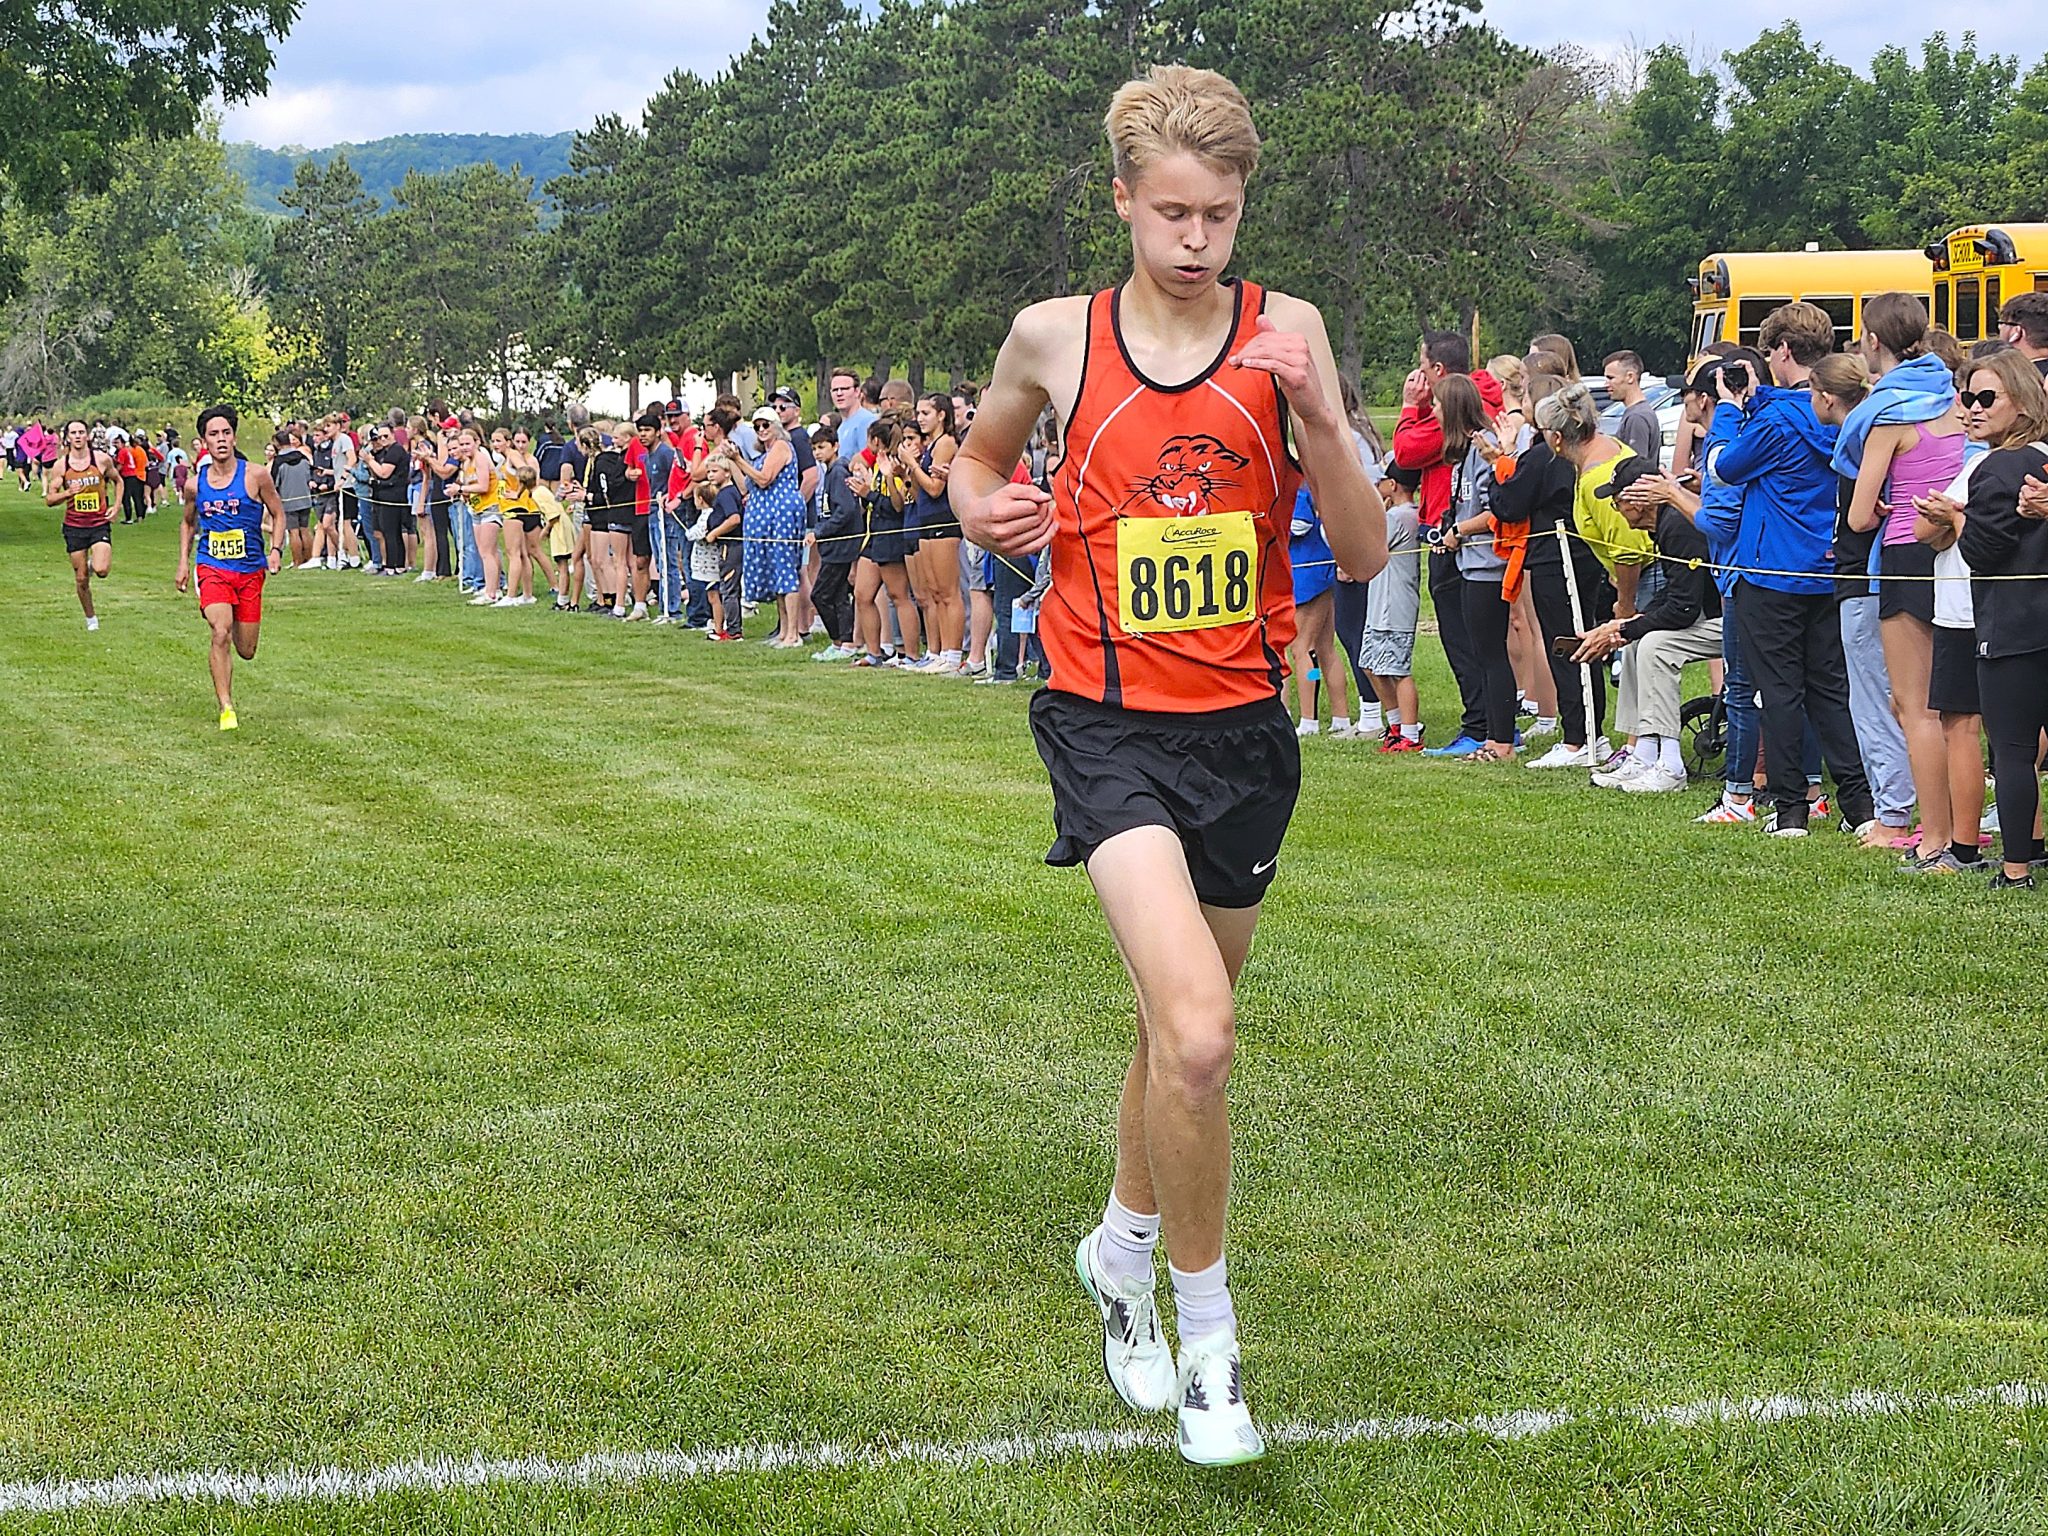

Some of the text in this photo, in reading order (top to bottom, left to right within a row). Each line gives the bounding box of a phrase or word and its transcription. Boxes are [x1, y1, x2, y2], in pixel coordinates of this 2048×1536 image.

[77, 499, 97, 510] 8561
[212, 539, 243, 556] 8455
[1130, 550, 1249, 621] 8618
